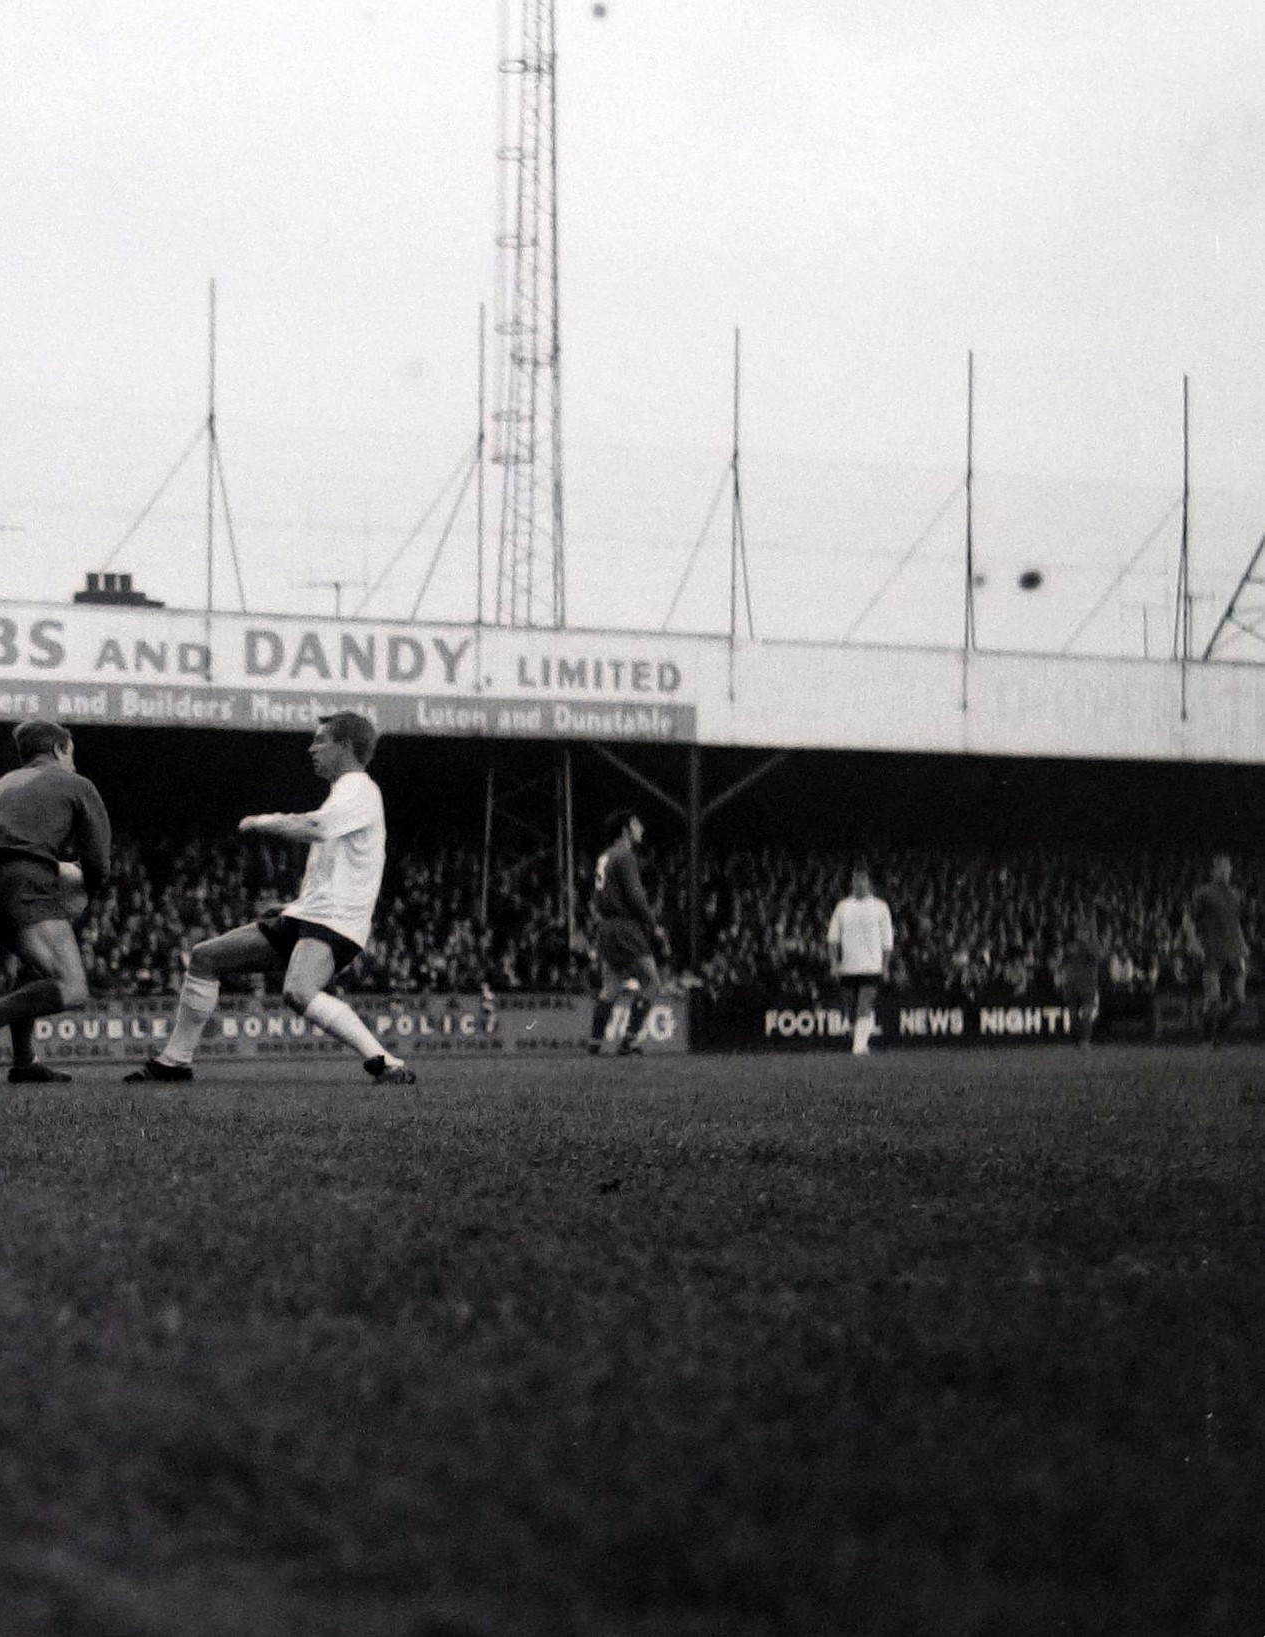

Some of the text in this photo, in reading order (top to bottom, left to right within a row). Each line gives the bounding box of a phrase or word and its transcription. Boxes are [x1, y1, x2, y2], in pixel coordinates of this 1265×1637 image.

[96, 637, 210, 675] AND
[517, 655, 682, 692] LIMITED
[58, 689, 107, 715] and
[34, 1018, 169, 1040] DOUBLE
[899, 1006, 965, 1037] NEWS
